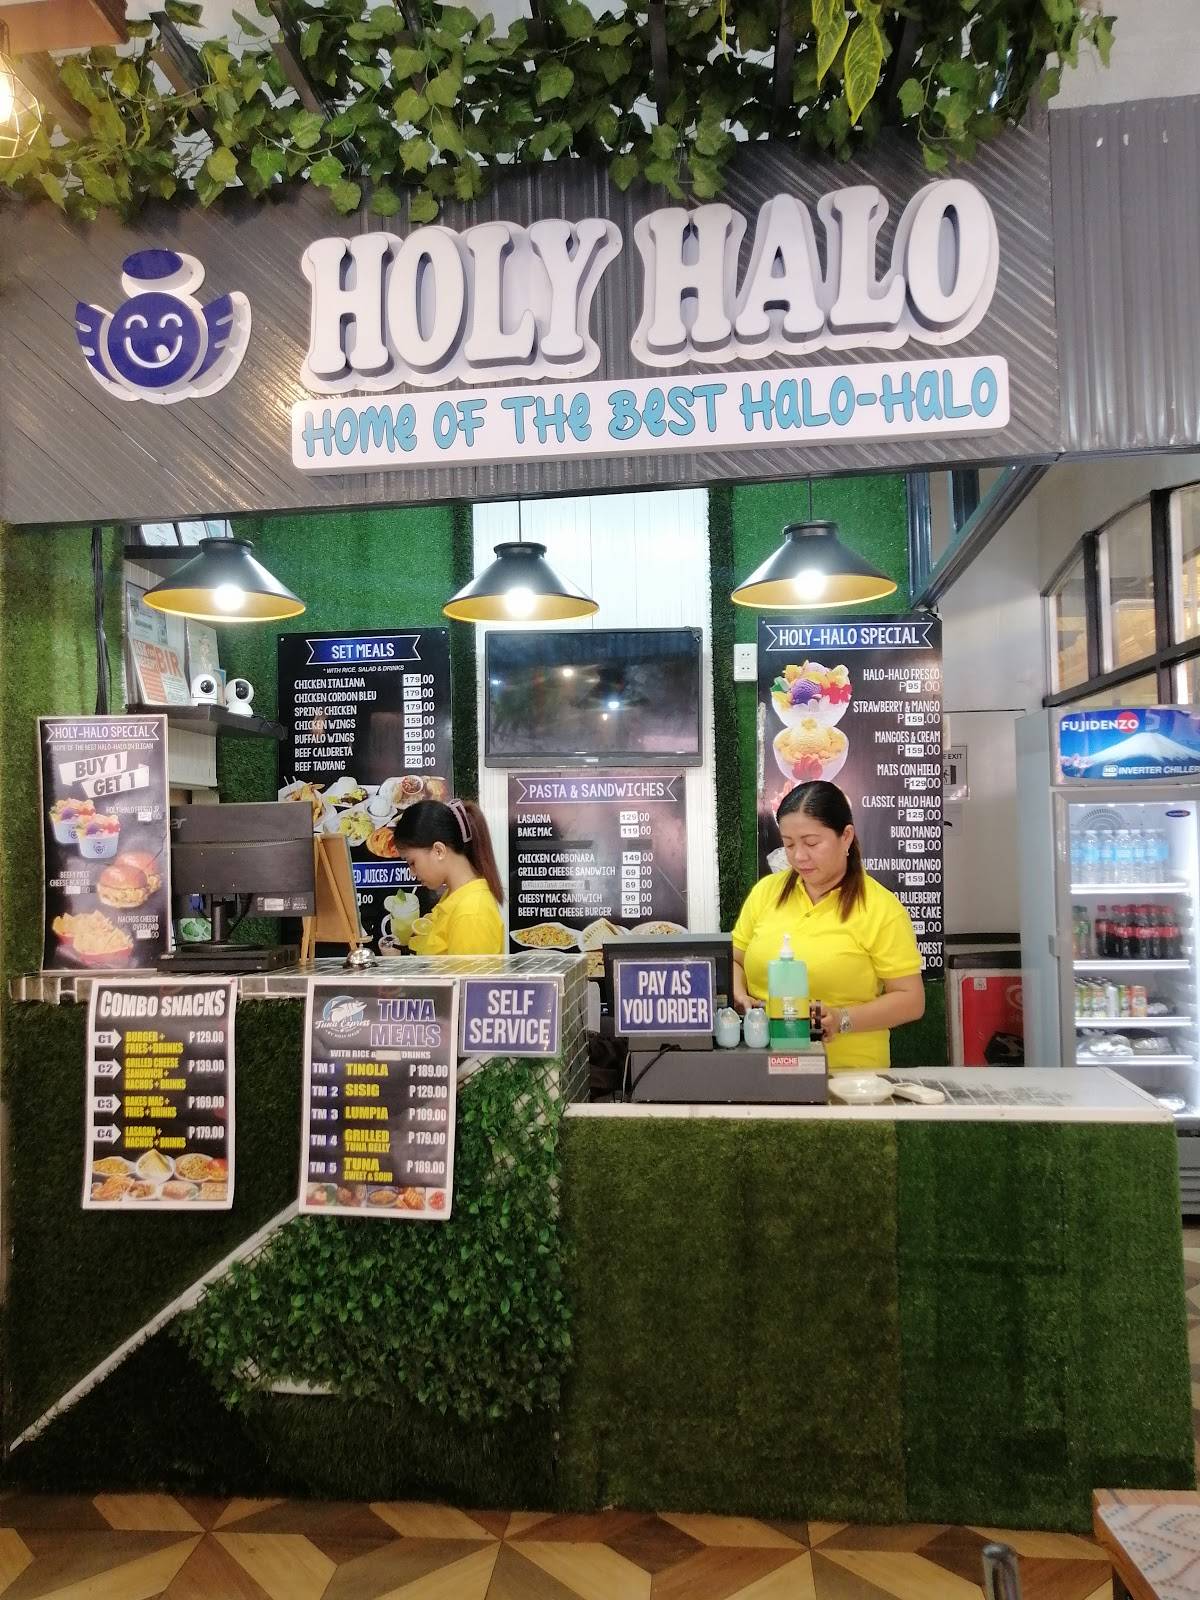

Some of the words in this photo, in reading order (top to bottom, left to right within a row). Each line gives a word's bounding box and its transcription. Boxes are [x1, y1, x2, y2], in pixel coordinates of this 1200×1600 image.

[307, 218, 608, 379] HOLY
[647, 179, 991, 354] HALO
[433, 399, 487, 450] OF
[779, 628, 858, 646] HOLY-HALO
[860, 627, 920, 645] SPECIAL
[331, 645, 353, 659] SET
[356, 643, 395, 658] MEALS
[863, 669, 910, 680] HALO-HALO
[911, 668, 940, 680] FRESCO
[294, 680, 327, 689] CHICKEN
[328, 678, 365, 688] ITALIANA
[294, 693, 327, 703] CHICKEN
[328, 692, 358, 702] CORDON
[359, 691, 377, 701] BLEU
[294, 707, 323, 717] SPRING
[324, 705, 357, 715] CHICKEN
[853, 701, 904, 713] STRAWBERRY
[904, 701, 911, 712] &
[911, 700, 940, 712] MANGO
[294, 721, 328, 730] CHICKEN
[328, 719, 356, 729] WINGS
[1062, 720, 1139, 732] FUJIDENZO
[55, 726, 108, 739] HOLY-HALO
[110, 726, 150, 738] SPECIAL
[294, 735, 326, 744] BUFFALO
[327, 733, 355, 743] WINGS
[875, 731, 910, 743] MANGOES
[910, 731, 916, 743] &
[917, 731, 940, 743] CREAM
[294, 749, 312, 758] BEEF
[313, 746, 353, 757] CALDERETA
[75, 756, 108, 778] BUY
[115, 754, 121, 769] 1
[294, 762, 312, 771] BEEF
[313, 760, 346, 771] TADYANG
[877, 764, 898, 776] MAIS
[900, 764, 917, 775] CON
[918, 764, 941, 775] HIELO
[1119, 766, 1160, 774] INVERTER
[93, 776, 122, 796] GET
[128, 772, 136, 788] 1
[529, 784, 567, 798] PASTA
[570, 785, 578, 798] &
[581, 782, 665, 797] SANDWICHES
[862, 796, 895, 808] CLASSIC
[898, 796, 919, 807] HALO
[920, 796, 941, 807] HALO
[518, 814, 551, 824] LASAGNA
[518, 827, 537, 837] BAKE
[538, 827, 552, 836] MAC
[891, 826, 911, 838] BUKO
[912, 826, 941, 838] MANGO
[518, 854, 550, 864] CHICKEN
[551, 853, 595, 863] CARBONARA
[891, 859, 911, 870] BUKO
[912, 858, 941, 870] MANGO
[363, 869, 388, 883] JUICES
[395, 868, 416, 881] SMO
[518, 867, 547, 877] GRILLED
[549, 867, 574, 877] CHEESE
[575, 866, 615, 876] SANDWICH
[518, 894, 545, 904] CHEESY
[545, 894, 560, 903] MAC
[562, 894, 602, 904] SANDWICH
[900, 892, 941, 904] BLUEBERRY
[518, 907, 539, 917] BEEFY
[540, 907, 557, 917] MELT
[558, 907, 584, 917] CHEESE
[585, 906, 612, 916] BURGER
[921, 907, 941, 918] CAKE
[917, 942, 942, 954] OREST
[638, 970, 670, 995] PAY
[671, 970, 692, 995] AS
[100, 990, 158, 1017] COMBO
[161, 990, 226, 1016] SNACKS
[488, 989, 535, 1015] SELF
[378, 999, 436, 1021] TUNA
[623, 999, 655, 1024] YOU
[656, 998, 709, 1023] ORDER
[371, 1024, 441, 1047] MEALS
[469, 1018, 551, 1044] SERVICE
[98, 1034, 111, 1043] C1
[352, 1050, 370, 1058] RICE
[402, 1051, 431, 1059] DRINKS
[98, 1064, 113, 1073] C2
[313, 1063, 328, 1073] TM
[330, 1063, 335, 1073] 1
[345, 1063, 389, 1076] TINOLA
[312, 1086, 327, 1096] TM
[332, 1087, 339, 1096] 2
[345, 1083, 380, 1096] SISIG
[97, 1099, 112, 1109] C3
[312, 1109, 327, 1119] TM
[331, 1109, 338, 1119] 3
[345, 1106, 389, 1119] LUMPIA
[97, 1129, 112, 1139] C4
[311, 1135, 327, 1146] TM
[330, 1135, 337, 1146] 4
[344, 1129, 390, 1142] GRILLED
[310, 1162, 325, 1173] TM
[330, 1163, 337, 1173] 5
[344, 1157, 380, 1170] TUNA
